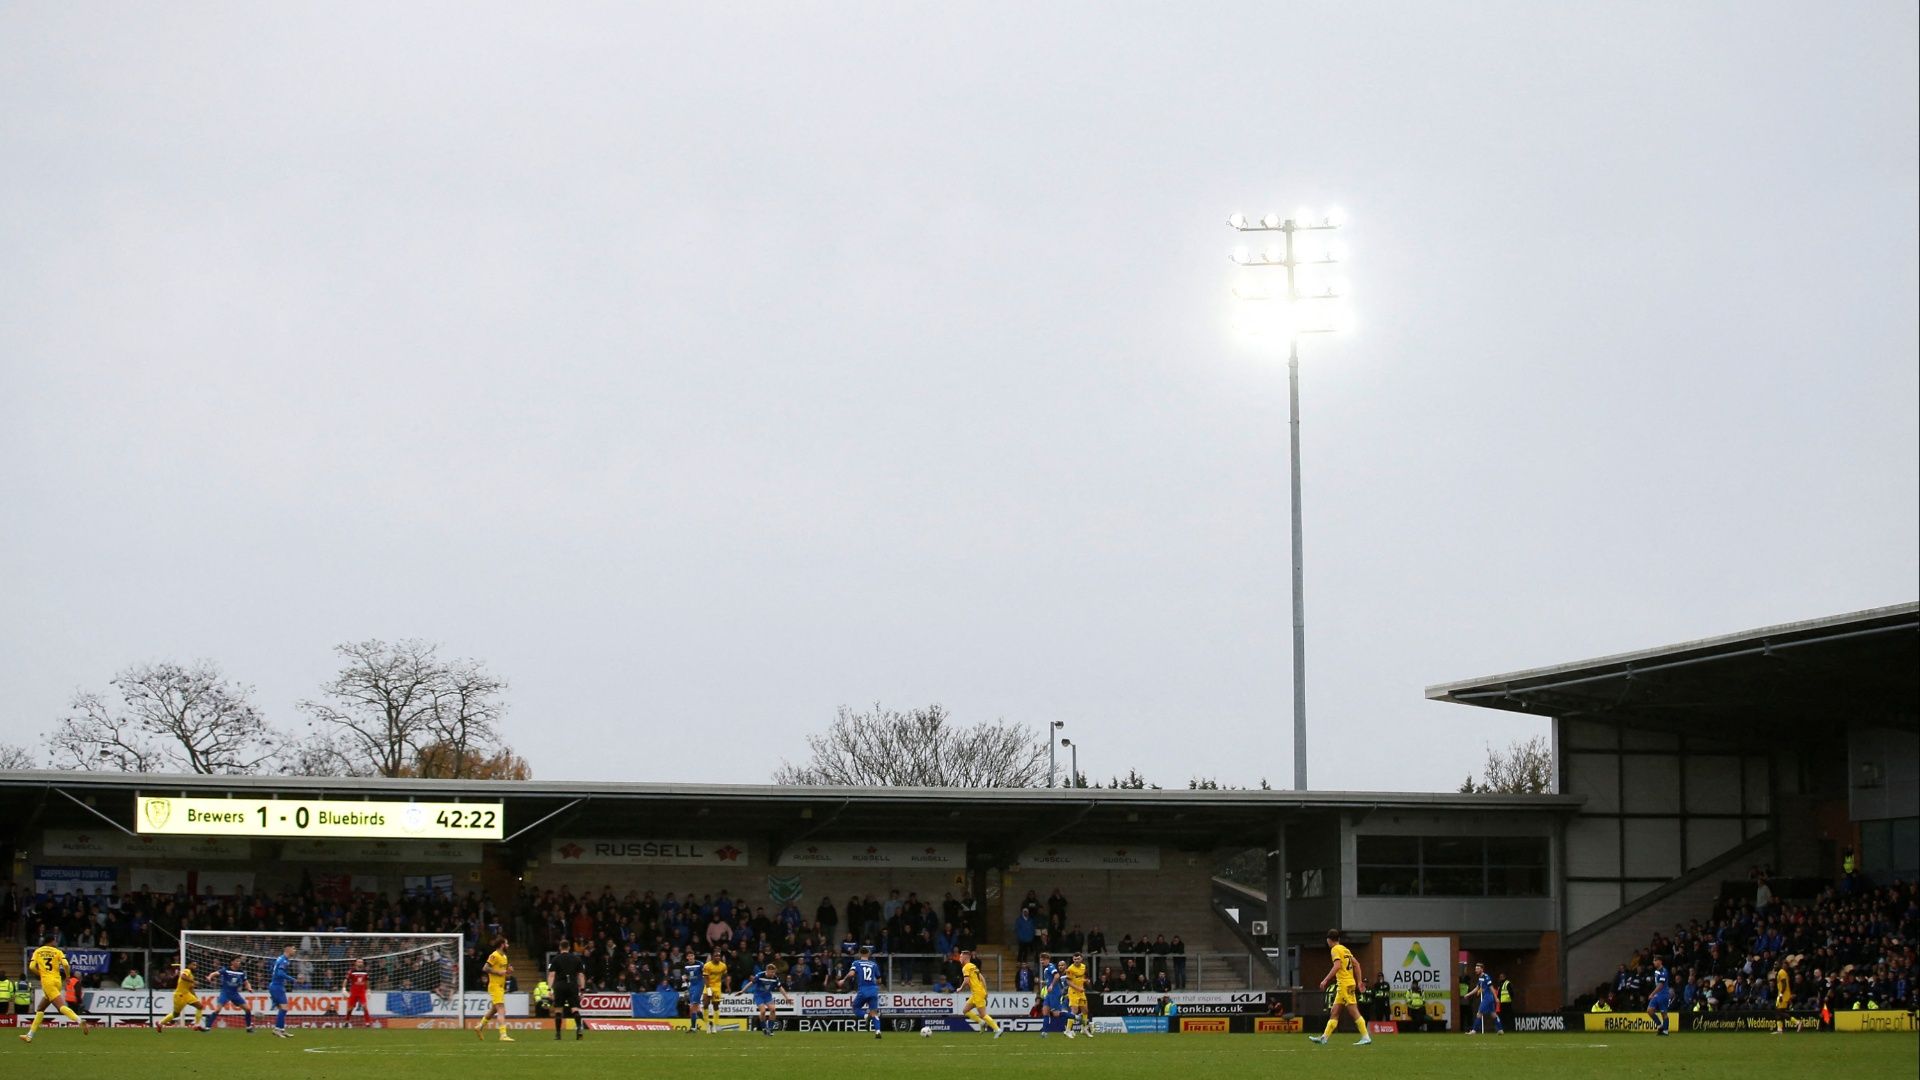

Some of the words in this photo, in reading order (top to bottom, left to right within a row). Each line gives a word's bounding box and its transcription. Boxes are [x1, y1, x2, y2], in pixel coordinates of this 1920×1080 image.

[188, 808, 245, 823] Brewers
[257, 806, 267, 828] 1
[296, 806, 310, 829] 0
[319, 811, 385, 826] Bluebirds
[436, 810, 496, 828] 42:22
[596, 842, 704, 859] RUSSELL
[45, 957, 53, 971] 3
[70, 954, 107, 965] ARMY
[863, 966, 872, 981] 12
[1393, 971, 1441, 983] ABODE
[97, 995, 166, 1009] PRESTEC
[801, 996, 823, 1008] Ian
[893, 995, 954, 1008] Butchers
[985, 997, 1030, 1009] AINS
[1106, 995, 1140, 1004] KIA
[1231, 993, 1263, 1003] KIA
[799, 1019, 877, 1032] BAYTREE
[1184, 1020, 1226, 1032] PIRELLI
[1259, 1020, 1300, 1032] PIRELLI
[1514, 1016, 1540, 1031] HARDY
[1540, 1016, 1565, 1031] SIGNS
[1746, 1016, 1777, 1031] Weddings
[1861, 1013, 1891, 1031] Home
